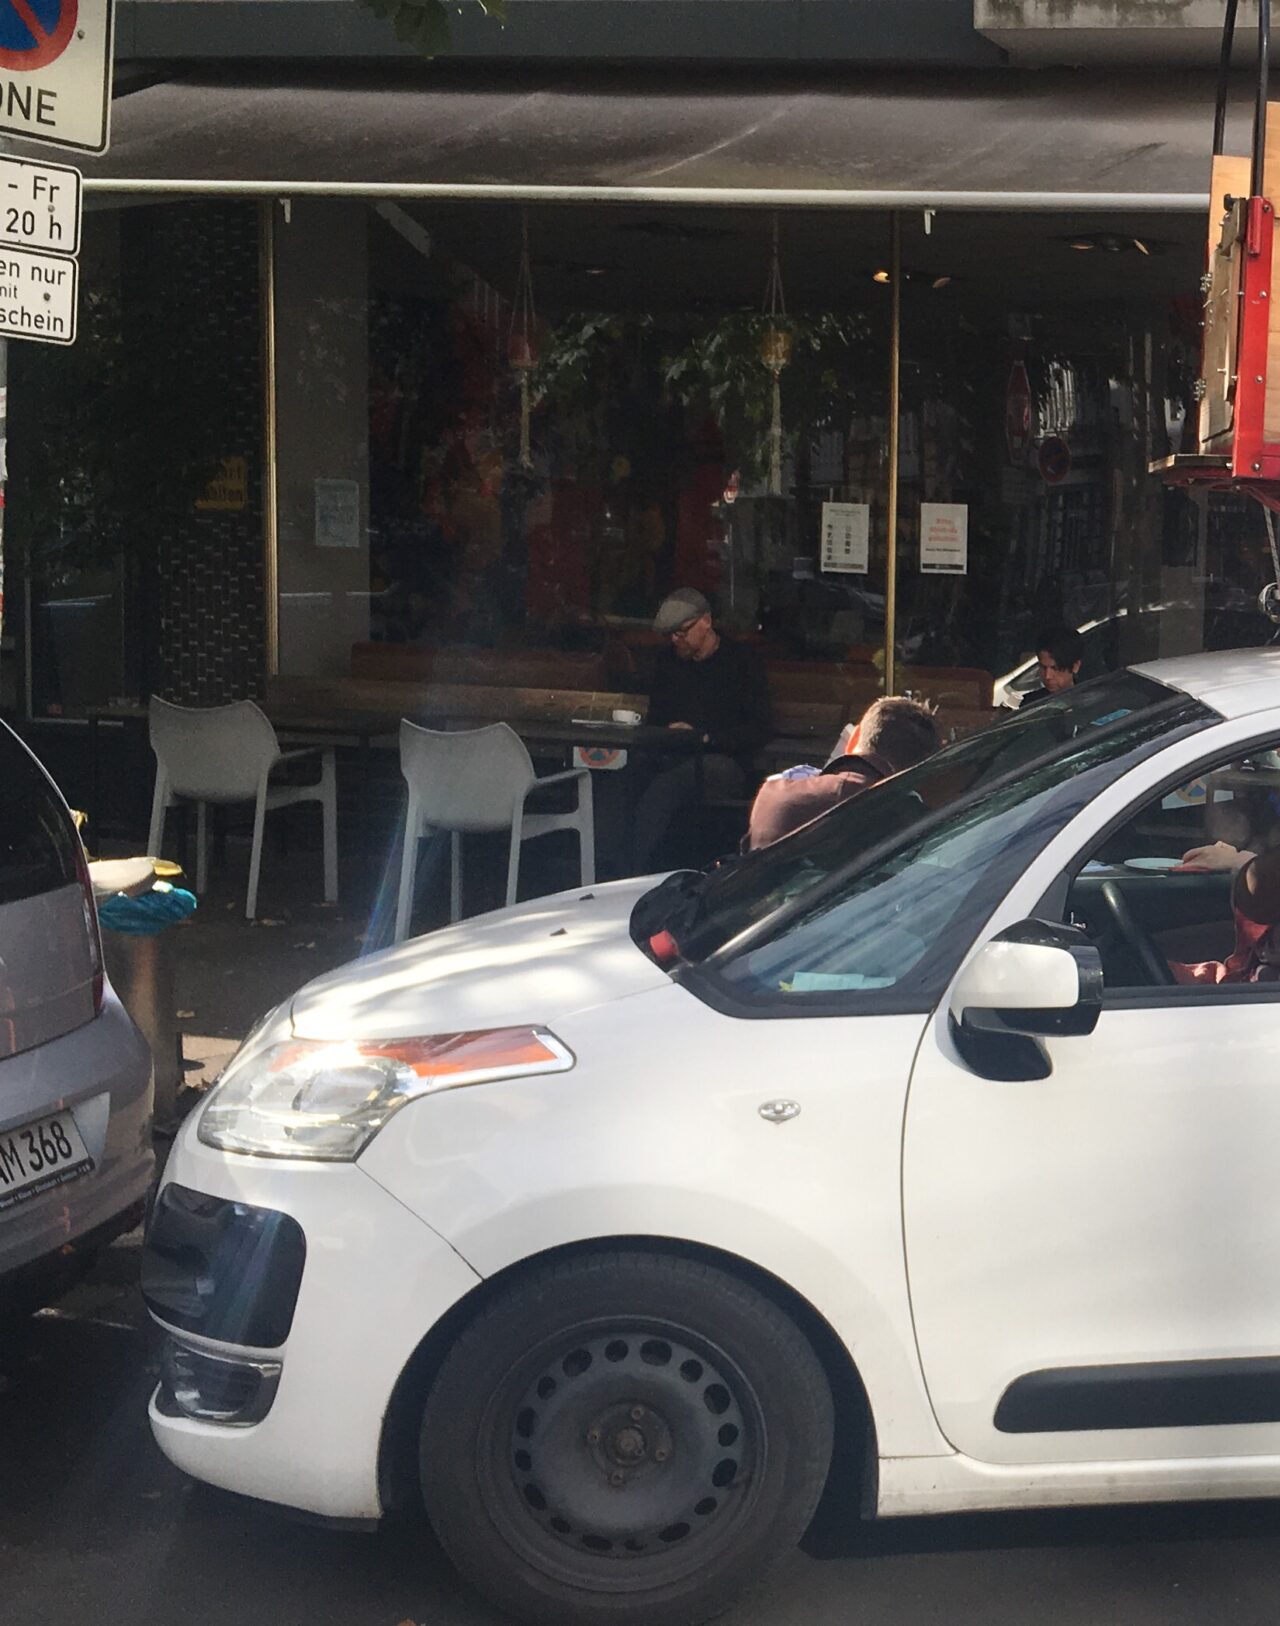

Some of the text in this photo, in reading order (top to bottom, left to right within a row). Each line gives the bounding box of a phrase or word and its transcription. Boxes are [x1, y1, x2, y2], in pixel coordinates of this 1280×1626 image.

[0, 81, 57, 126] NE
[33, 175, 60, 203] Fr
[6, 207, 62, 240] 20 h
[31, 266, 66, 285] nur
[20, 1121, 73, 1171] 368
